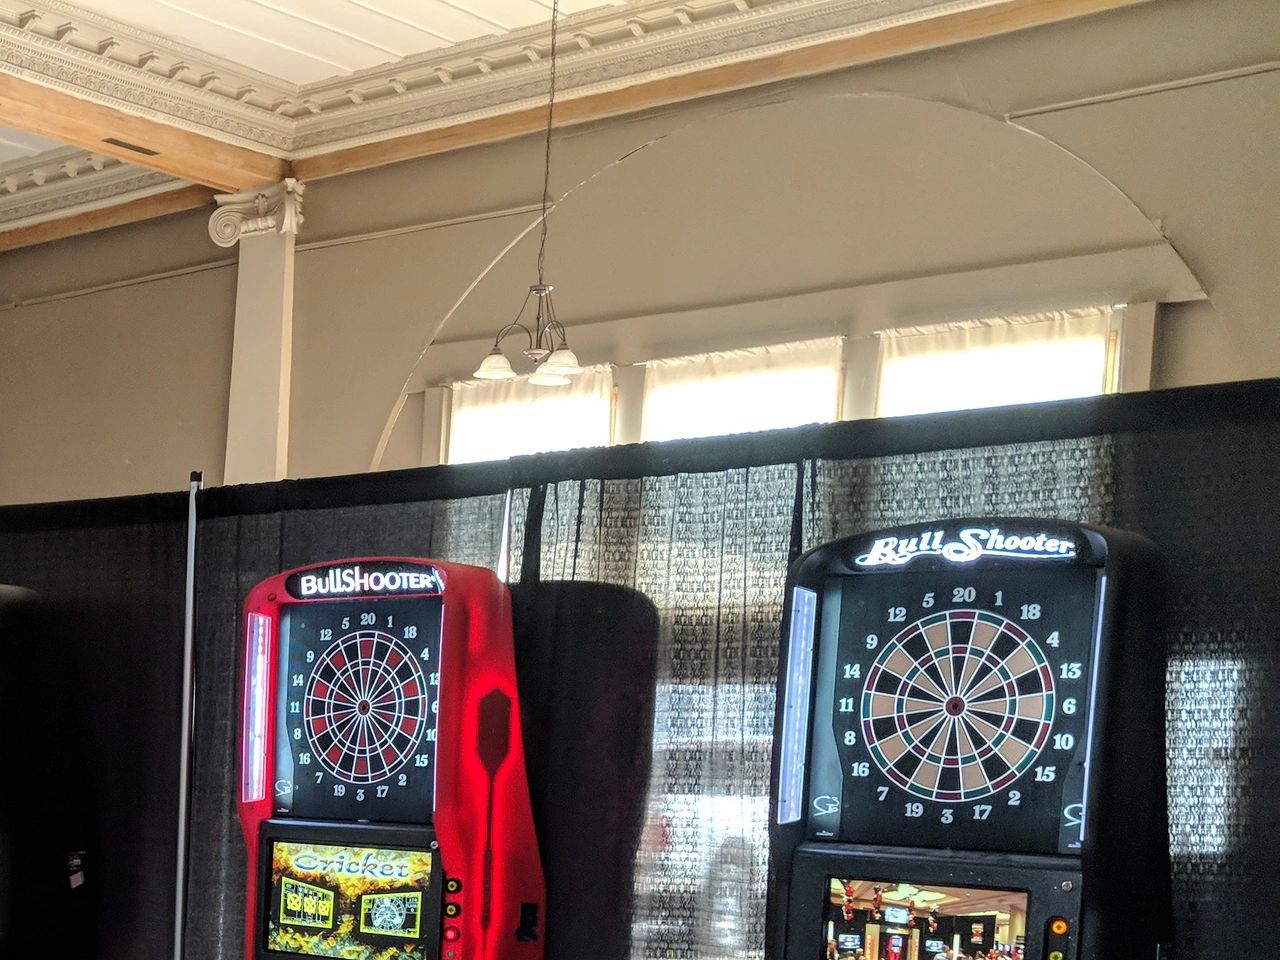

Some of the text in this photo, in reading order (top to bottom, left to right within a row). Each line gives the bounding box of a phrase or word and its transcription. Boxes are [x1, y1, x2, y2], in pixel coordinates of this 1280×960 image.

[855, 529, 1076, 566] Bull Shooter
[922, 593, 934, 608] 5
[952, 587, 976, 602] 20
[994, 591, 1002, 605] 1
[361, 613, 376, 625] 20
[888, 607, 906, 622] 12
[1020, 604, 1041, 620] 18
[342, 618, 350, 629] 5
[387, 616, 393, 628] 1
[320, 629, 332, 640] 12
[404, 626, 417, 638] 18
[867, 634, 878, 649] 9
[1047, 632, 1059, 647] 4
[306, 651, 314, 662] 9
[420, 648, 429, 660] 4
[844, 665, 861, 679] 14
[1060, 663, 1081, 679] 13
[292, 675, 304, 687] 14
[290, 702, 300, 713] 11
[839, 699, 854, 712] 11
[1063, 699, 1076, 714] 6
[294, 729, 302, 740] 8
[844, 731, 856, 745] 8
[1053, 734, 1073, 749] 10
[299, 753, 310, 765] 16
[415, 755, 428, 766] 15
[852, 762, 869, 777] 16
[1035, 766, 1056, 782] 15
[316, 772, 323, 784] 7
[398, 774, 407, 785] 2
[334, 785, 345, 796] 19
[356, 789, 364, 800] 3
[376, 786, 388, 798] 17
[877, 787, 889, 801] 7
[1008, 791, 1020, 806] 2
[905, 803, 924, 818] 19
[941, 809, 953, 823] 3
[973, 804, 992, 819] 17
[294, 853, 409, 878] Cricket
